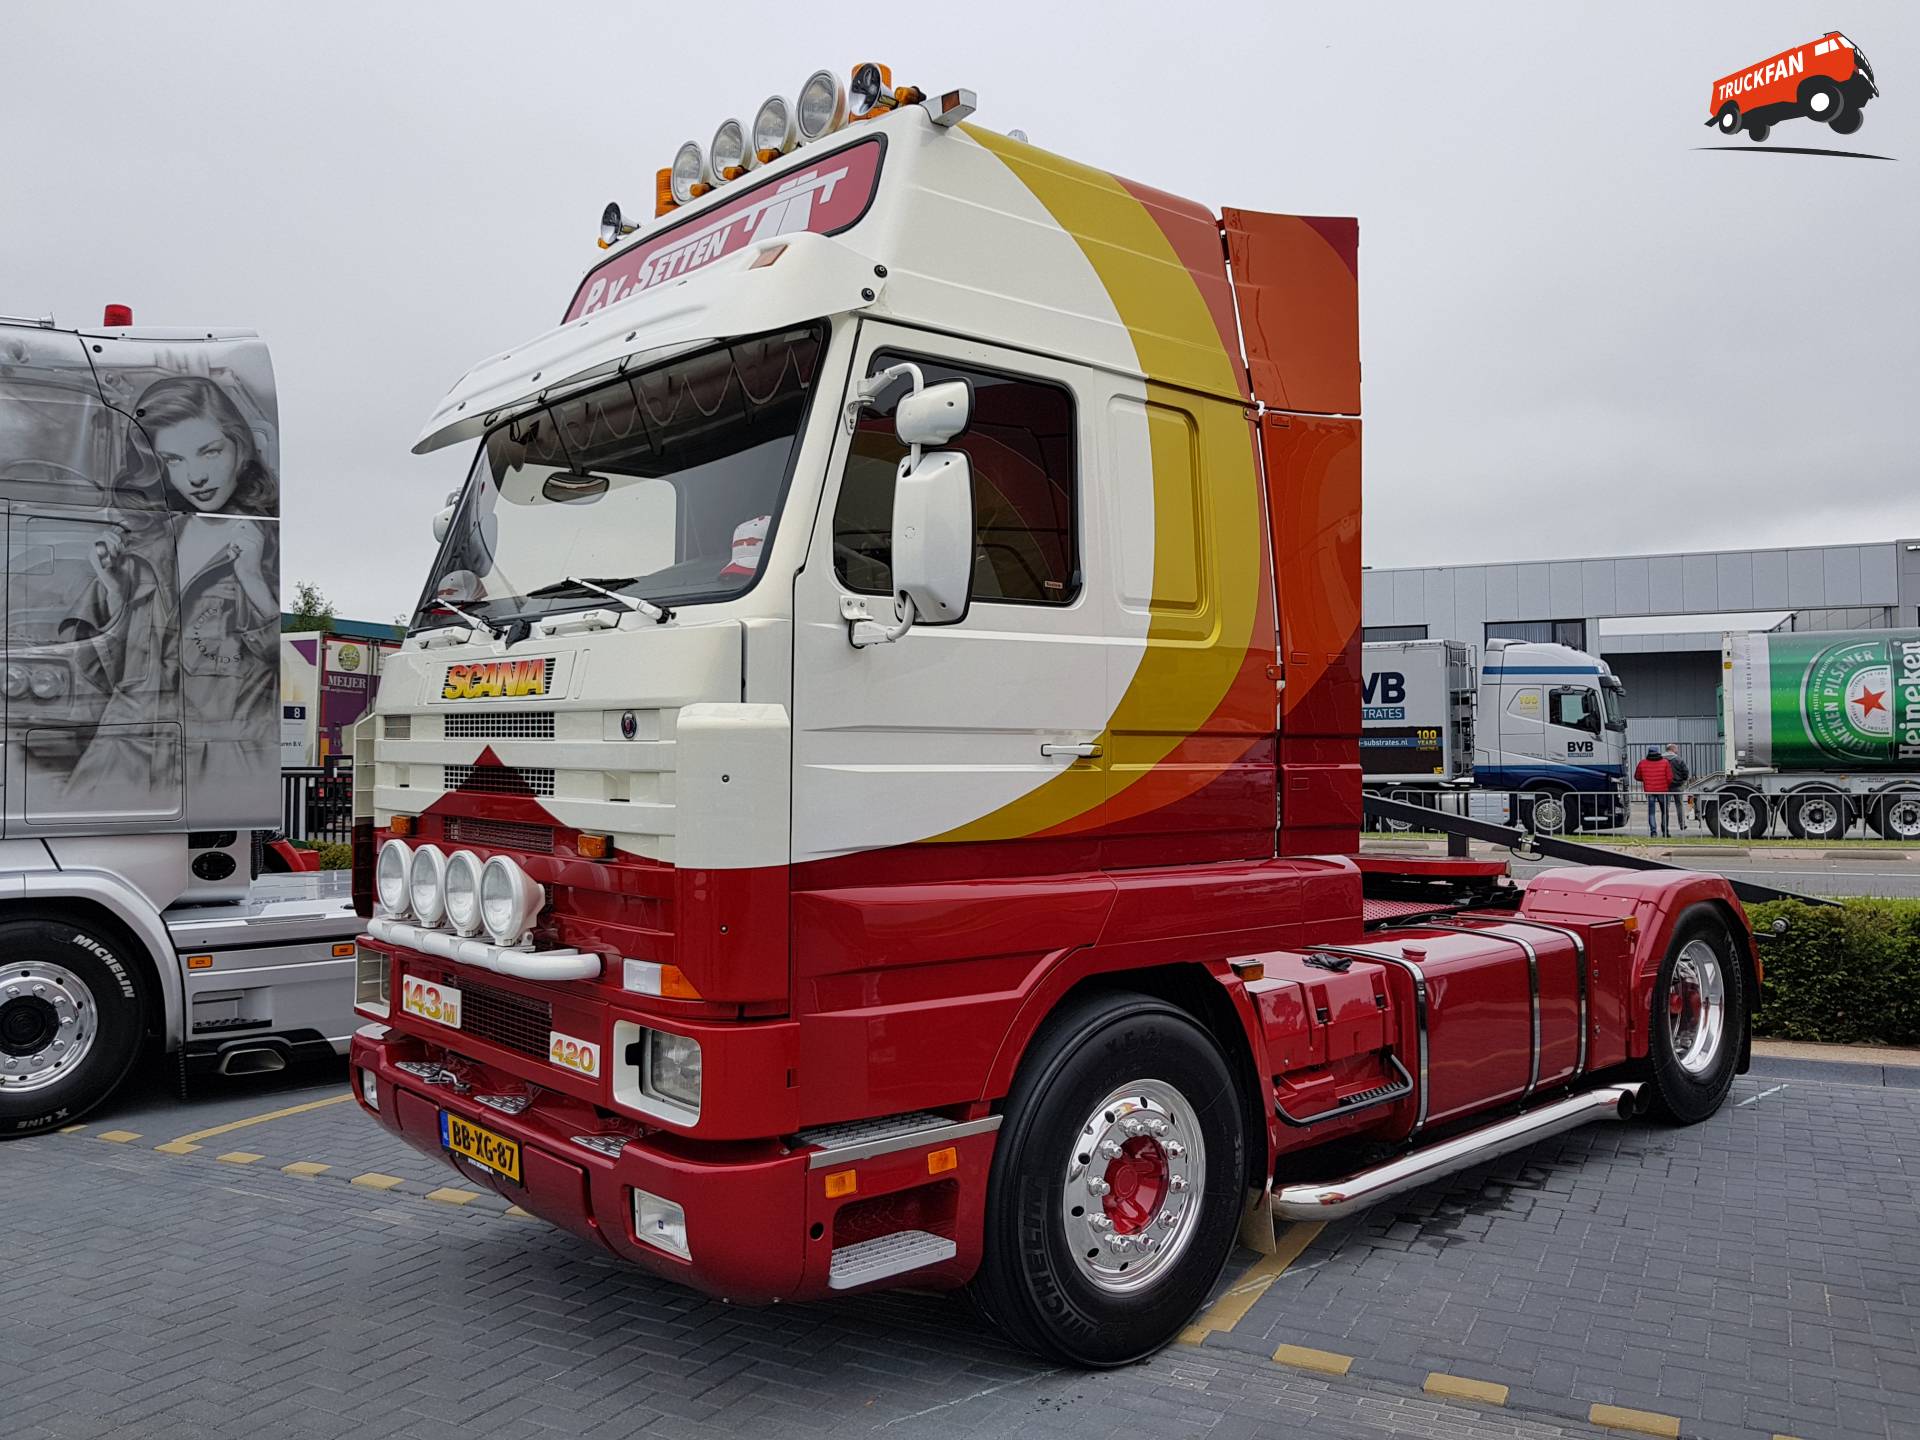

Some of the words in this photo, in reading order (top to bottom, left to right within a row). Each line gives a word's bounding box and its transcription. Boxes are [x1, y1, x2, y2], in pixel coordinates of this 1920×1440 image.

[444, 658, 545, 699] SCANIA
[1361, 671, 1406, 705] VB
[1823, 650, 1874, 697] PILSENER
[294, 707, 301, 719] 8
[1361, 708, 1402, 719] TRATES
[1899, 641, 1920, 760] Heineken
[1361, 739, 1408, 747] -substrates.nl
[1416, 730, 1437, 740] 100
[1823, 702, 1877, 753] HEINEKEN
[1567, 741, 1594, 752] BVB
[72, 933, 136, 999] MICHELIN
[551, 1038, 596, 1073] 420
[16, 1115, 53, 1129] LINE
[55, 1107, 69, 1120] X
[451, 1120, 515, 1172] BB-XG-87
